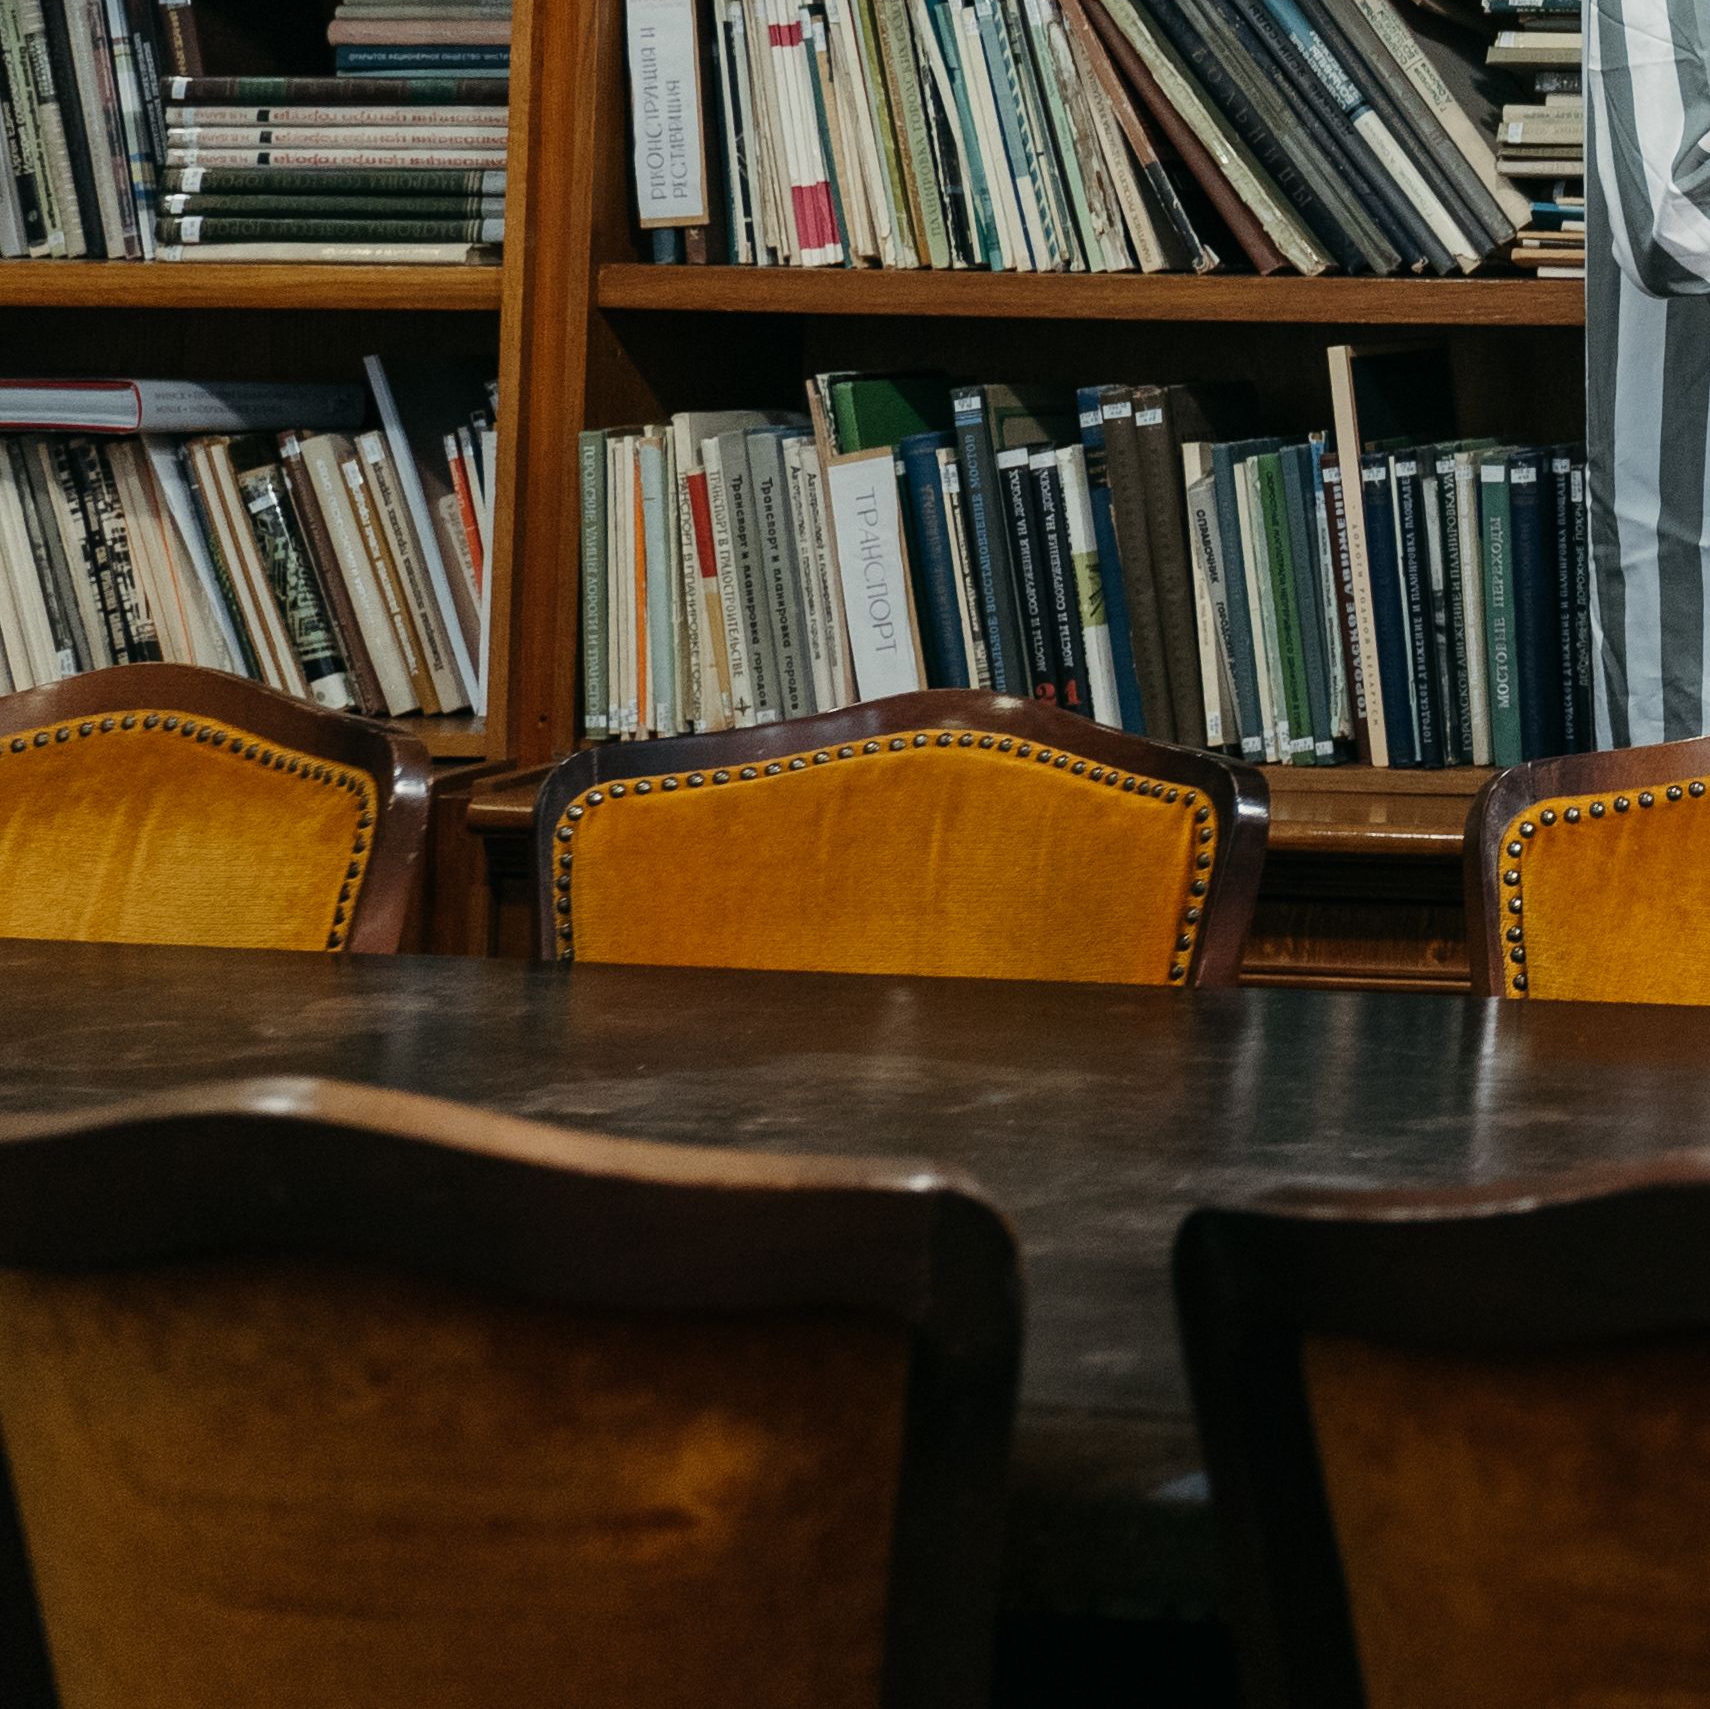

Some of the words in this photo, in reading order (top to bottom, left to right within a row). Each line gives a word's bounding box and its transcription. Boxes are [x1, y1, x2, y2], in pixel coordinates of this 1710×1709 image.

[963, 434, 983, 489] МОСТОВ
[1008, 469, 1027, 518] ДОРОГАХ
[709, 470, 729, 535] ТРАНСПОРТ
[720, 549, 745, 678] ГРАДОСТРОИТЕЛЬСТВЕ
[853, 486, 898, 657] ТРАНСПОРТ
[971, 492, 999, 612] ВОССТАНОВЛЕНИЕ
[1019, 538, 1041, 615] СООРУЖЕНИЯ
[1045, 538, 1069, 610] СООРУЖЕНИЯ
[1195, 509, 1219, 584] СПРАВОЧНИК
[1405, 531, 1424, 606] ПЛАНИРОВКА
[1443, 498, 1461, 581] ПЛАНИРОВКА
[1488, 515, 1506, 608] ПЕРЕХОДЫ
[1555, 527, 1569, 602] ПЛАНИРОВКА
[730, 475, 750, 548] Транспорт
[742, 564, 762, 645] планировка
[752, 651, 769, 708] городов
[760, 477, 778, 551] Транспорт
[771, 568, 792, 649] планировка
[783, 654, 800, 710] городов
[1030, 629, 1047, 672] МОСТЫ
[1413, 616, 1429, 681] ДВИЖЕНИЕ
[1449, 594, 1468, 669] ДВИЖЕНИЕ
[1491, 616, 1511, 708] МОСТОВЫЕ
[1419, 682, 1433, 743] ГОРОДСКОЕ
[1455, 670, 1474, 751] ГОРОДСКОЕ
[1563, 680, 1575, 740] ГОРОДСКОЕ
